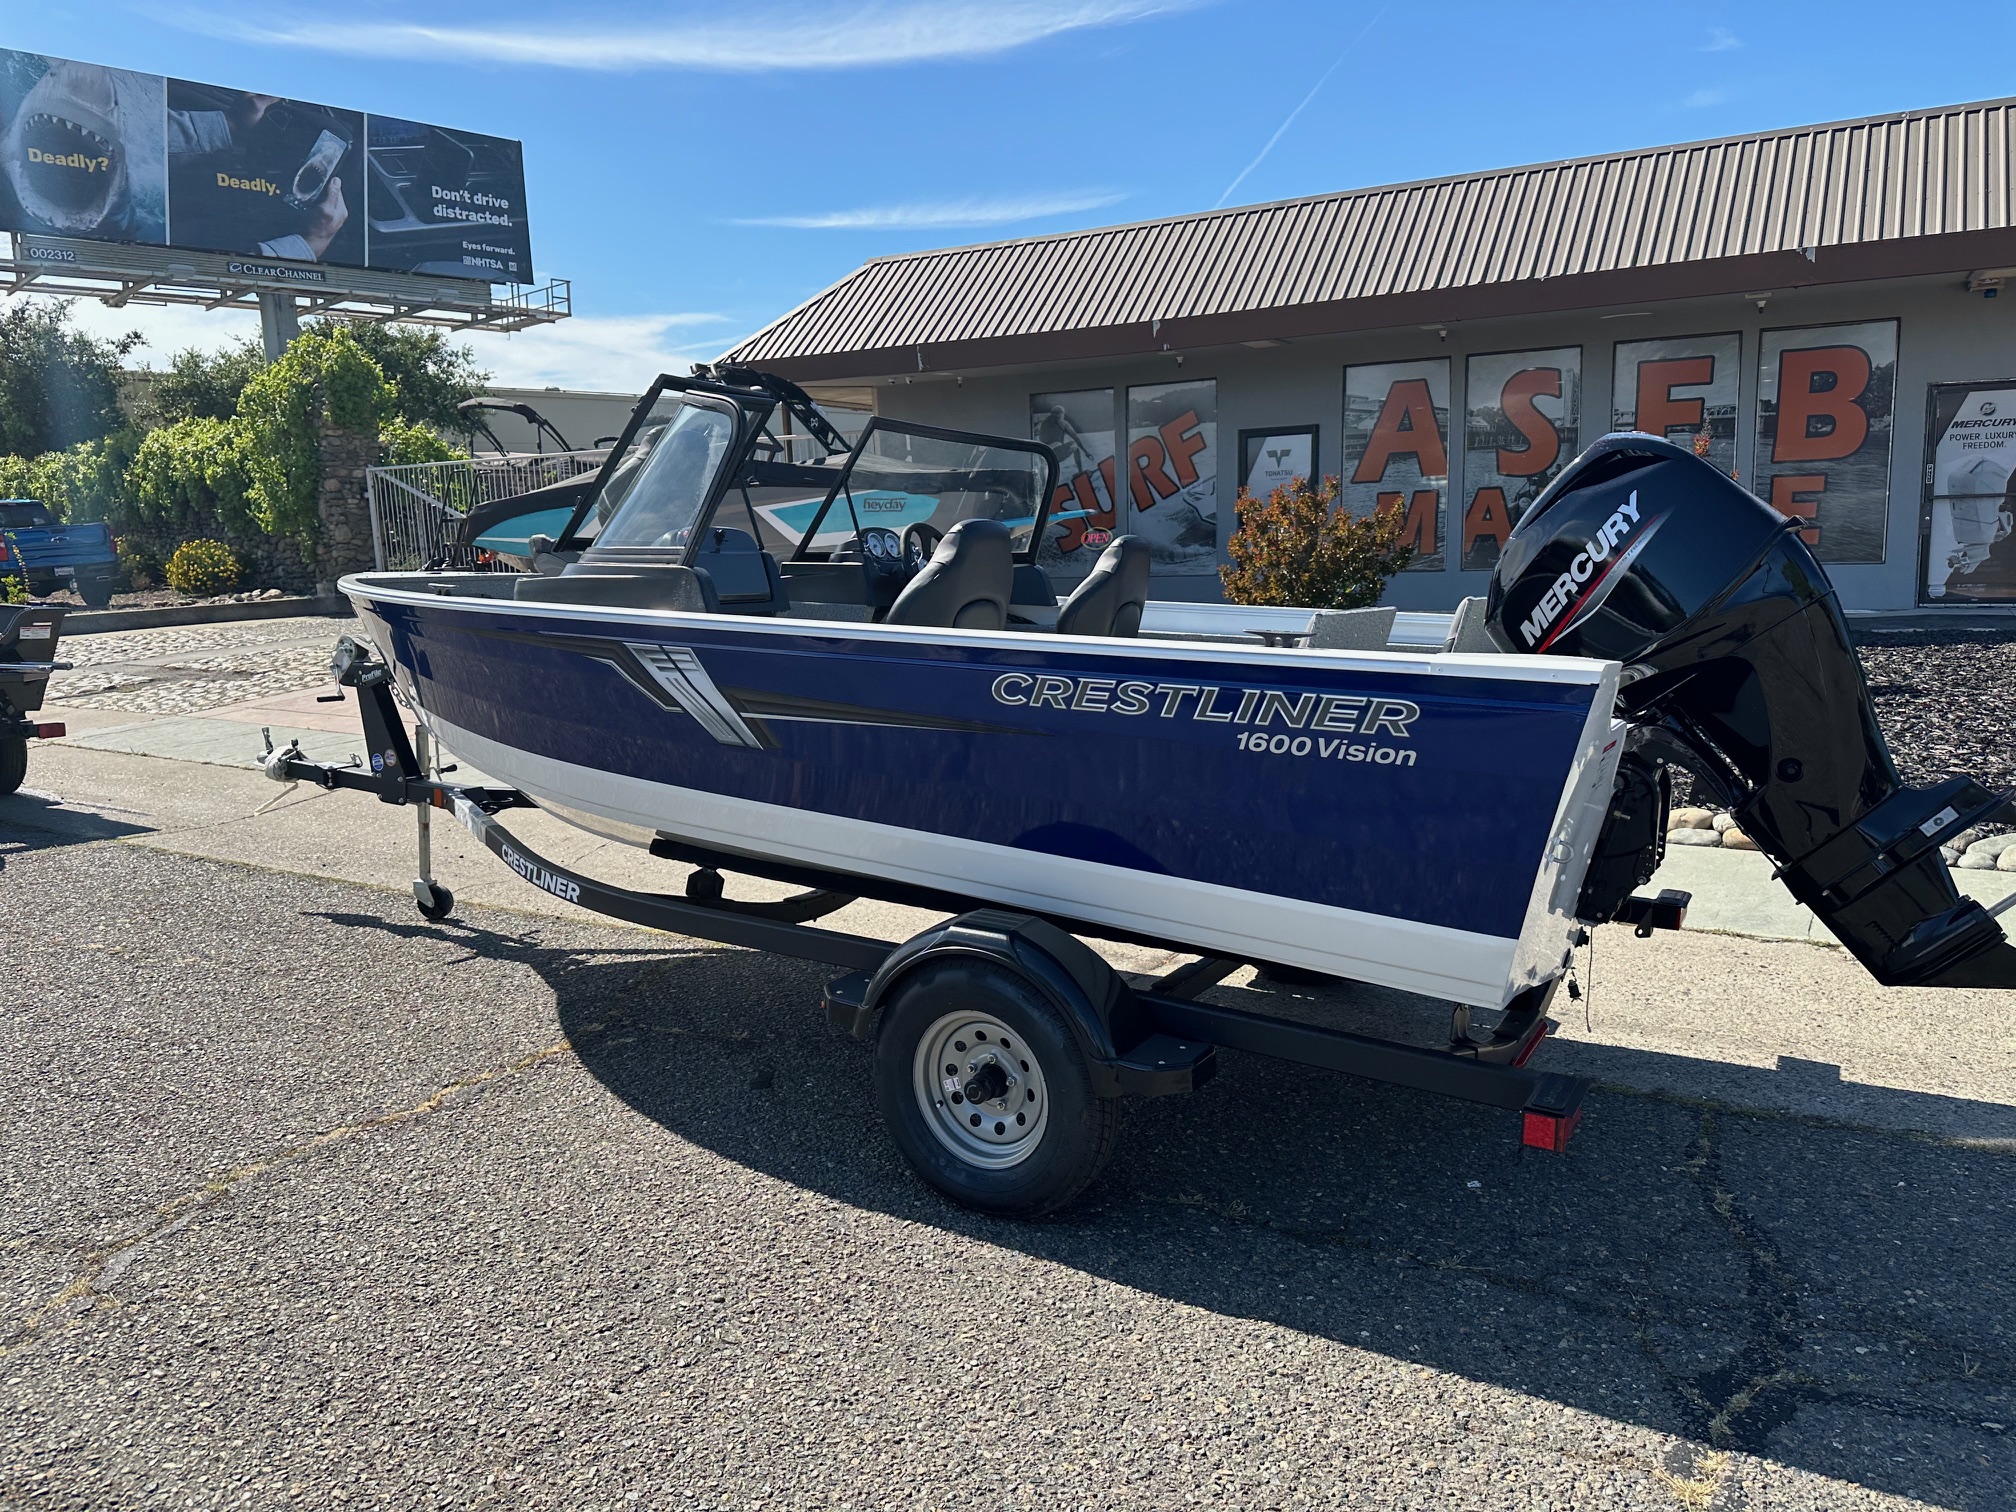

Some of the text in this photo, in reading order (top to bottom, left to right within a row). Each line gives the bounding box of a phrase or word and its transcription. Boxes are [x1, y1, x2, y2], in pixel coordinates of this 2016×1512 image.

[27, 148, 109, 173] Deadly?
[216, 172, 281, 196] Deadly.
[431, 185, 509, 209] Don't drive
[433, 204, 513, 227] distracted.
[30, 248, 75, 261] 002312
[462, 241, 516, 255] Eyes forward.
[471, 256, 504, 270] NHTSA
[1949, 433, 1983, 441] POWER.
[1962, 440, 2007, 450] FREEDOM.
[1048, 409, 1207, 554] SURF
[1265, 469, 1293, 477] TOHATSU
[863, 497, 907, 513] heyday
[1083, 532, 1109, 544] OPEN
[1520, 489, 1641, 647] MERCURY
[991, 672, 1420, 738] CRESTLINER
[1236, 731, 1417, 767] 1600 Vision
[501, 844, 580, 903] CRESTLINER
